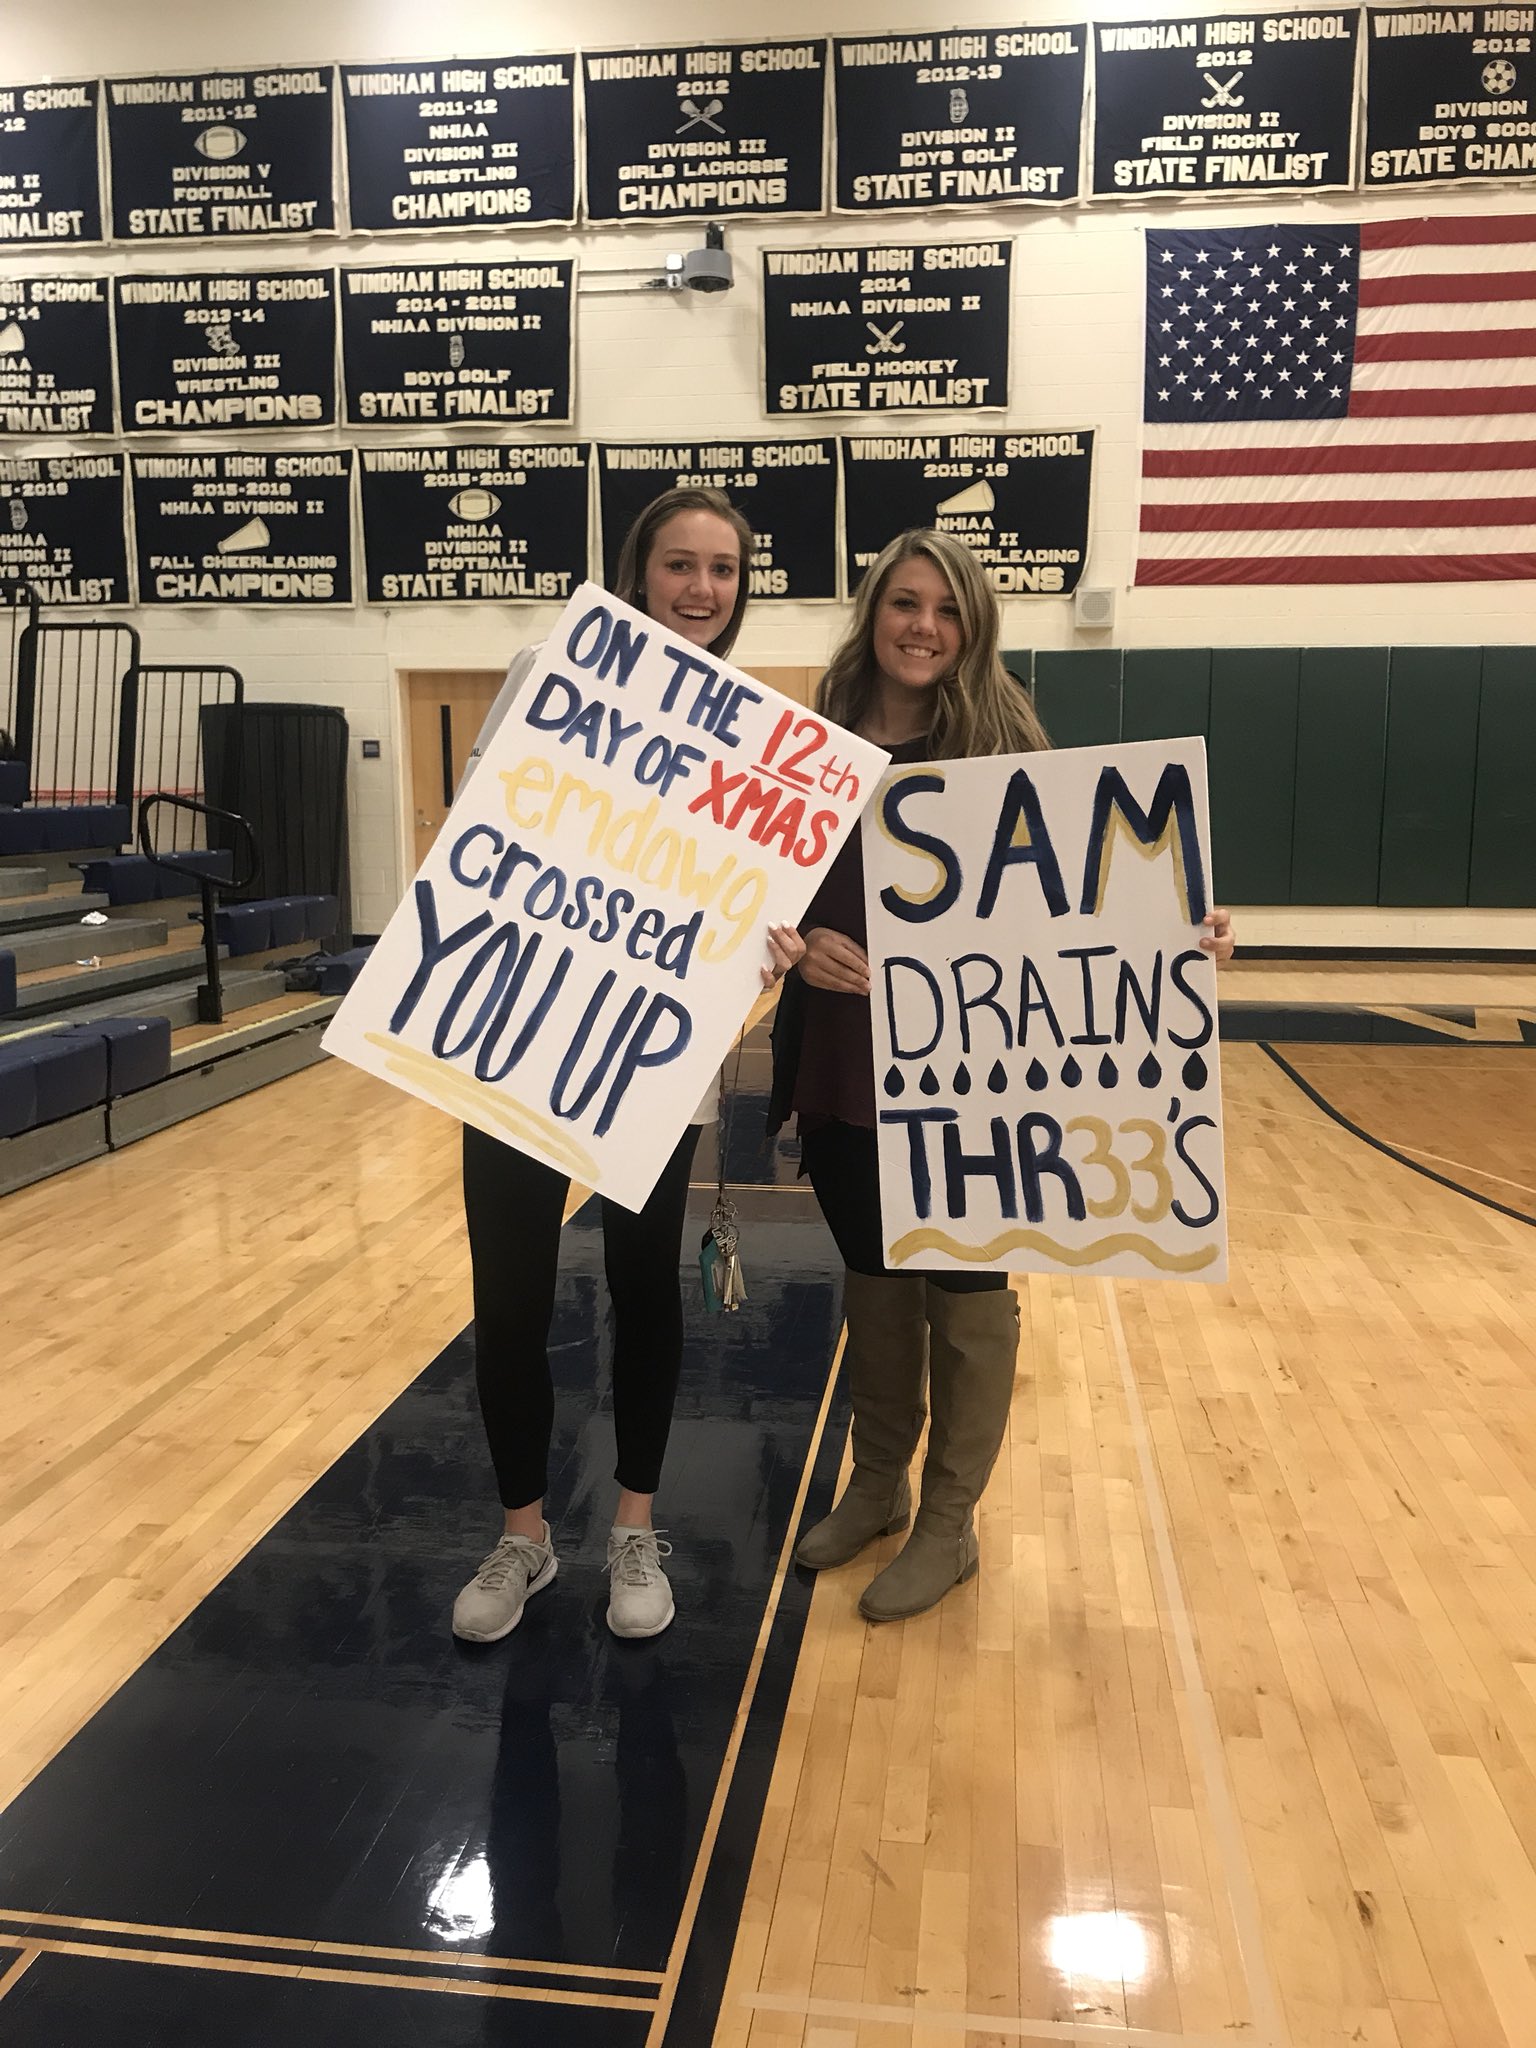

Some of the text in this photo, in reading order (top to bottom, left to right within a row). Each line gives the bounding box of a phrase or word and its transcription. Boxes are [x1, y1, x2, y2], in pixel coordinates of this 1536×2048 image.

[1100, 16, 1350, 52] WINDHAM HIGH SCHOOL
[1374, 10, 1534, 38] WINDHAM HIGH
[842, 32, 1078, 66] WINDHAM HIGH SCHOOL
[1472, 38, 1530, 53] 2012
[587, 47, 820, 81] WINDHAM HIGH SCHOOL
[1196, 50, 1252, 67] 2012
[348, 64, 569, 96] WINDHAM HIGH SCHOOL
[917, 65, 1002, 83] 2012-13
[111, 72, 327, 105] WINDHAM HIGH SCHOOL
[677, 80, 729, 96] 2012
[23, 87, 91, 111] SCHOOL
[419, 99, 497, 117] 2011-12
[1436, 100, 1527, 118] DIVISION
[182, 104, 257, 122] 2011-12
[1163, 112, 1279, 130] DIVISION II
[429, 123, 488, 139] NHIAA
[902, 127, 1015, 146] DIVISION II
[1420, 122, 1536, 140] BOYS SOC
[404, 143, 518, 162] DIVISION III
[648, 139, 766, 158] DIVISION III
[1142, 133, 1300, 152] FIELD HOCKEY
[900, 147, 1017, 167] BOYS GOLF
[1371, 146, 1456, 177] STATE
[173, 164, 270, 181] DIVISION V
[410, 166, 517, 185] WRESTLING
[619, 158, 787, 180] GIRLS LACROSSE
[1114, 152, 1328, 186] STATE FINALIST
[23, 175, 39, 188] II
[854, 167, 1064, 201] STATE FINALIST
[174, 185, 272, 201] FOOTBALL
[619, 178, 786, 211] CHAMPIONS
[393, 188, 531, 220] CHAMPIONS
[0, 211, 83, 238] NALIST
[129, 201, 317, 234] STATE FINALIST
[768, 244, 1005, 275] WINDHAM HIGH SCHOOL
[348, 267, 564, 294] WINDHAM HIGH SCHOOL
[861, 277, 910, 293] 2014
[31, 282, 103, 302] SCHOOL
[121, 278, 329, 304] WINDHAM HIGH SCHOOL
[397, 298, 447, 312] 2014
[466, 296, 516, 310] 2015
[791, 296, 980, 316] NHIAA DIVISION II
[372, 315, 541, 333] NHIAA DIVISION II
[173, 355, 280, 372] DIVISION III
[813, 360, 958, 378] FIELD HOCKEY
[176, 376, 279, 393] WRESTLING
[405, 369, 511, 385] BOYS GOLF
[360, 389, 553, 417] STATE FINALIST
[780, 379, 989, 409] STATE FINALIST
[136, 395, 322, 424] CHAMPIONS
[606, 444, 830, 469] WINDHAM HIGH SCHOOL
[850, 435, 1084, 460] WINDHAM HIGH SCHOOL
[48, 457, 120, 479] SCHOOL
[135, 456, 348, 478] WINDHAM HIGH SCHOOL
[363, 447, 585, 471] WINDHAM HIGH SCHOOL
[160, 501, 323, 515] NHIAA DIVISION II
[447, 524, 503, 538] NHIAA
[935, 516, 994, 531] NHIAA
[425, 540, 527, 555] DIVISION II
[999, 533, 1018, 546] II
[54, 549, 70, 561] II
[150, 556, 337, 569] FALL CHEERLEADING
[428, 556, 525, 570] FOOTBALL
[970, 549, 1079, 563] ERLEADING
[27, 564, 73, 577] GOLF
[16, 578, 114, 604] NALIST
[156, 574, 333, 597] CHAMPIONS
[383, 572, 571, 598] STATE FINALIST
[566, 605, 861, 802] ON THE 12th
[525, 672, 840, 868] DAY OF XMAS
[875, 763, 1206, 925] SAM
[499, 757, 769, 963] emdawg
[450, 823, 705, 979] crossed
[389, 879, 693, 1138] YOU UP
[881, 946, 1213, 1060] DRAINS
